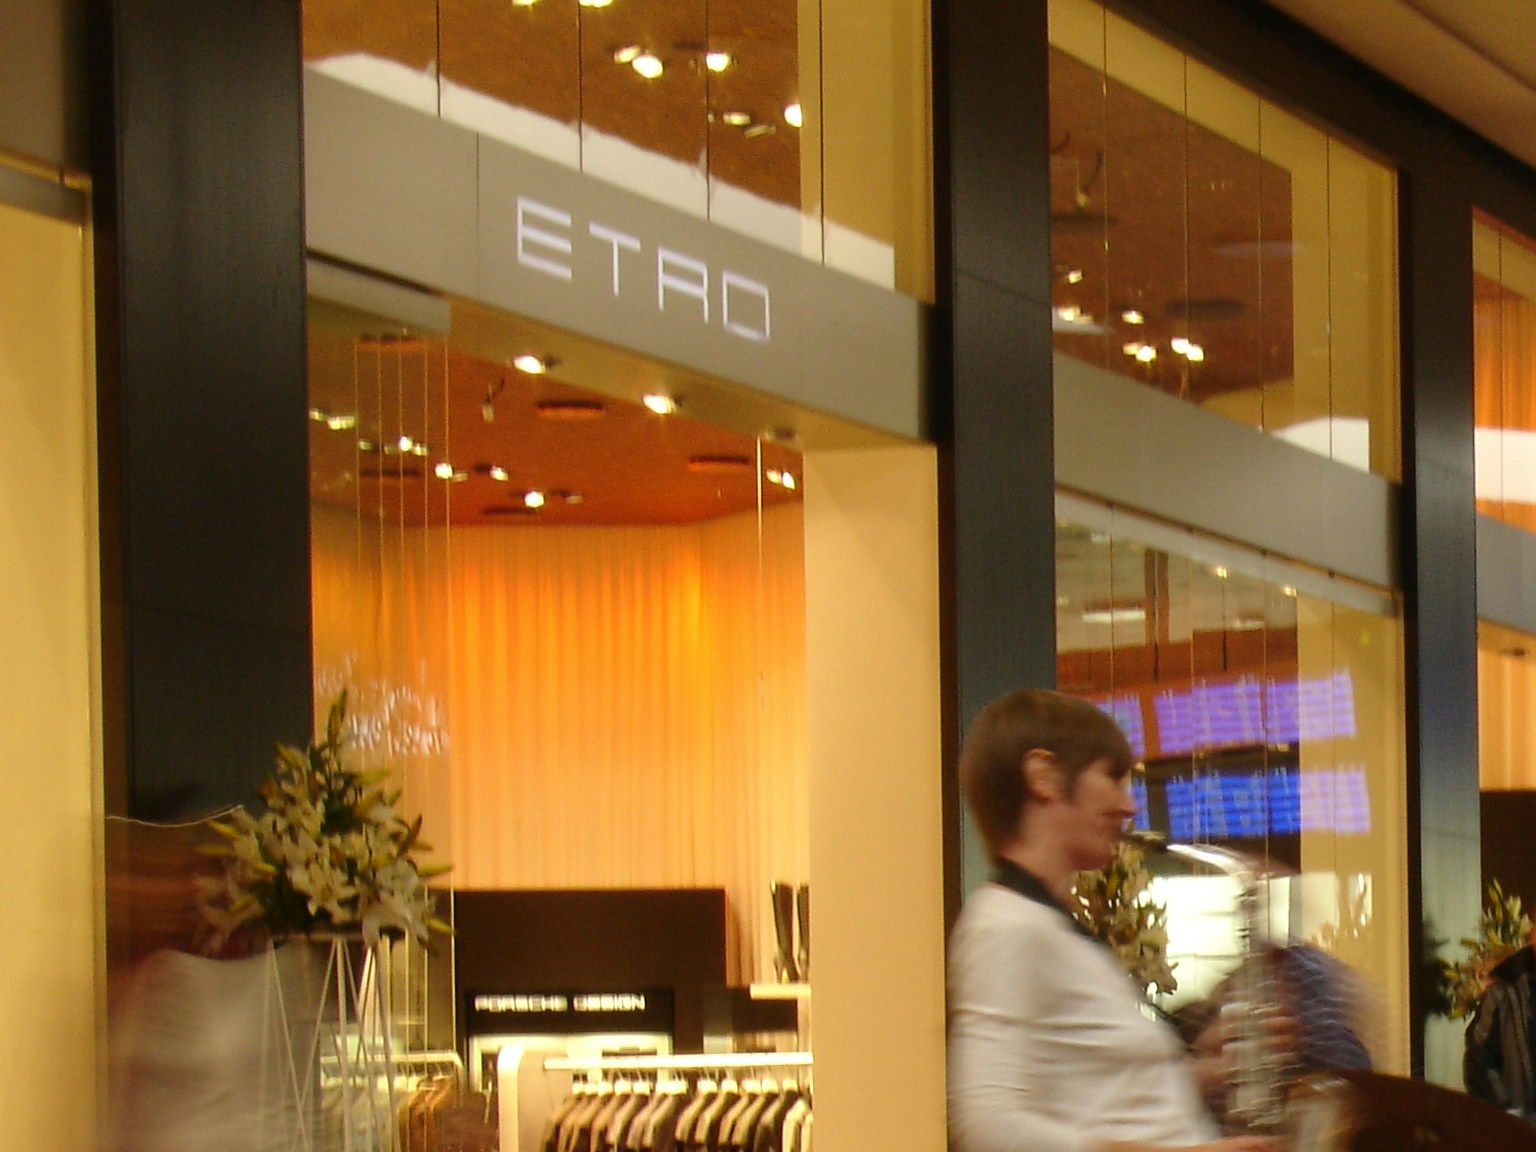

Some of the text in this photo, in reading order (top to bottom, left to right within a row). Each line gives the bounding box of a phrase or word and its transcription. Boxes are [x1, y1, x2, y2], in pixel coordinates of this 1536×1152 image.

[516, 196, 770, 342] ETRO
[475, 993, 646, 1012] PORSCHE DESIGN
